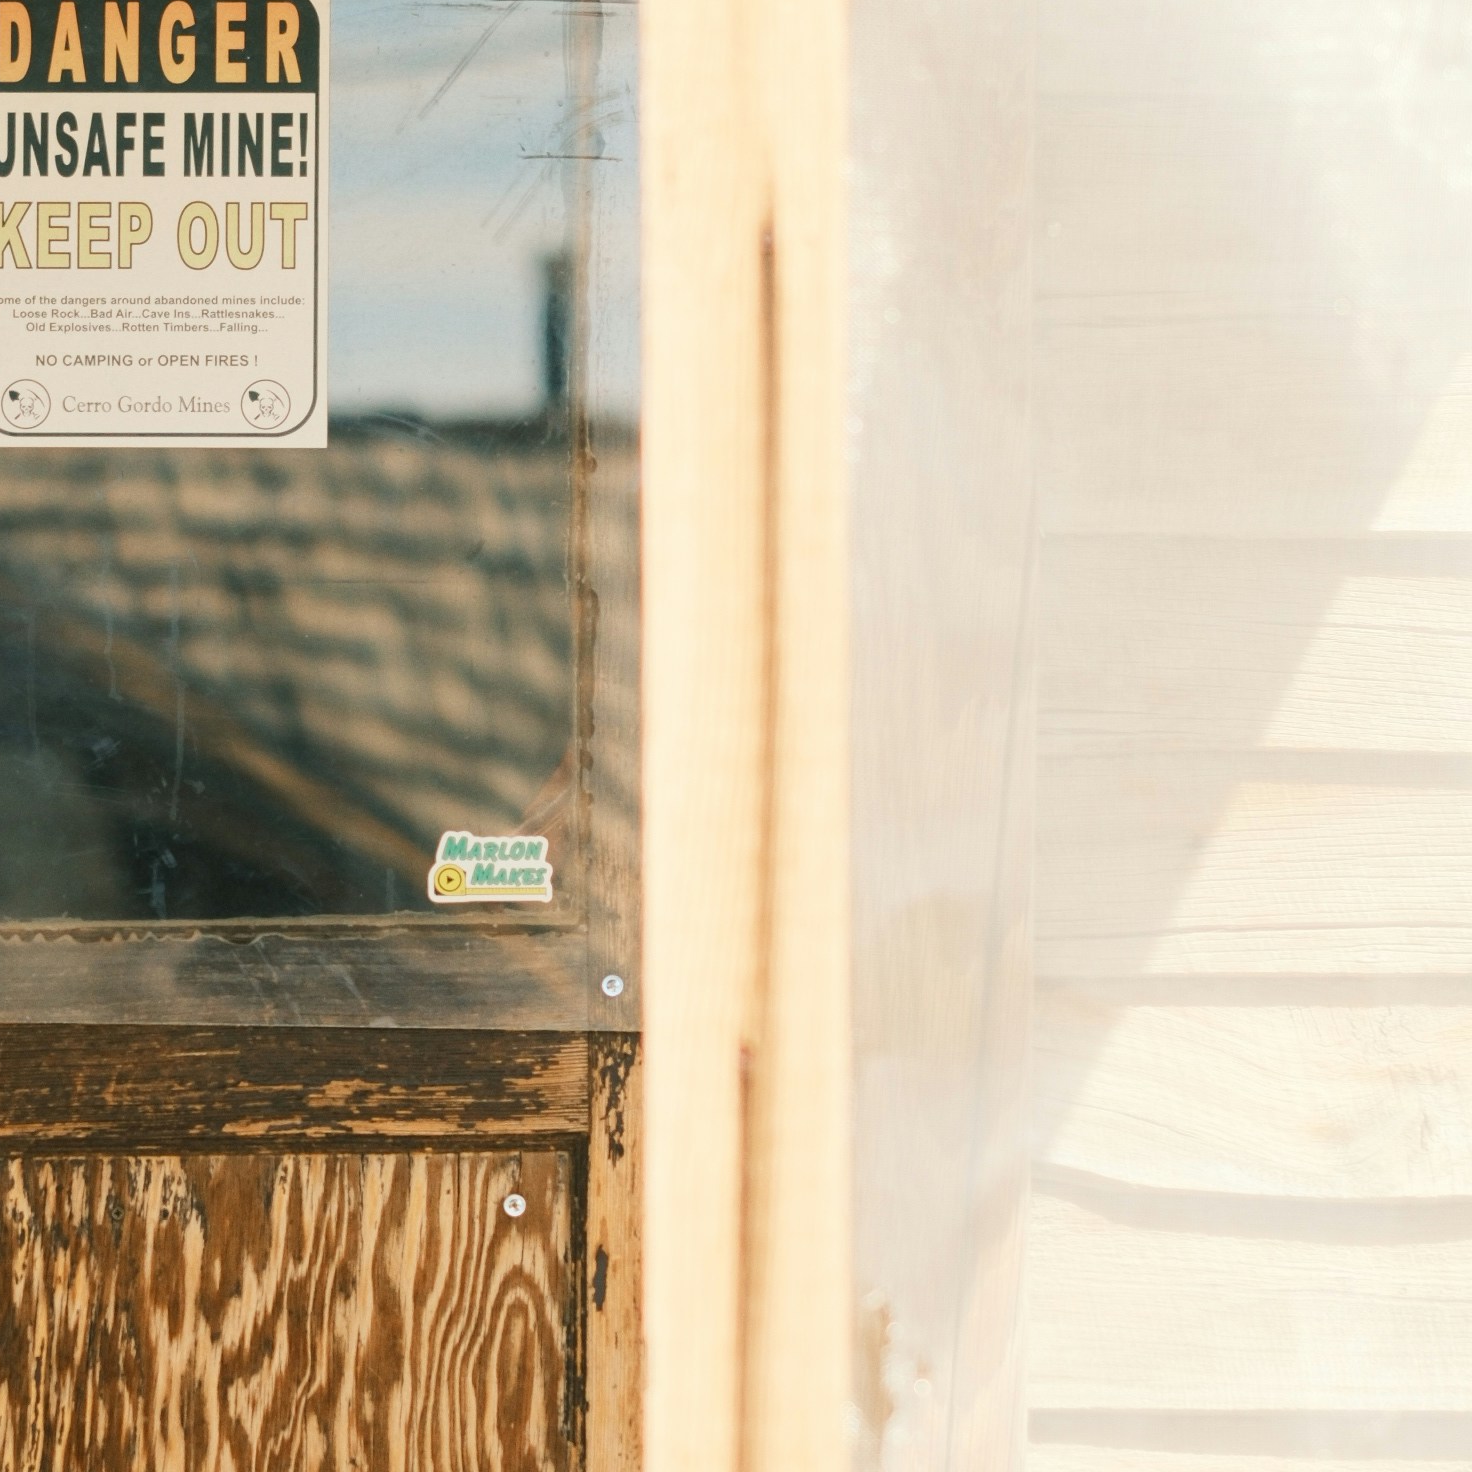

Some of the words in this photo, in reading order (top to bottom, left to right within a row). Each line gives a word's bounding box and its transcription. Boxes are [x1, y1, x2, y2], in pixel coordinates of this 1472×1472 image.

[183, 112, 309, 178] MINE!
[176, 200, 309, 271] OUT
[24, 294, 37, 305] of
[39, 294, 57, 305] the
[60, 295, 107, 308] dangers
[110, 295, 151, 305] around
[154, 295, 219, 306] abandoned
[221, 295, 256, 306] mines
[260, 295, 306, 306] include:
[12, 308, 48, 319] Loose
[26, 322, 46, 332] Old
[35, 354, 58, 367] NO
[62, 354, 134, 367] CAMPING
[138, 357, 154, 367] or
[157, 354, 201, 367] OPEN
[205, 354, 250, 367] FIRES
[62, 395, 112, 414] Cerro
[117, 395, 173, 414] Gordo
[178, 395, 232, 414] Mines
